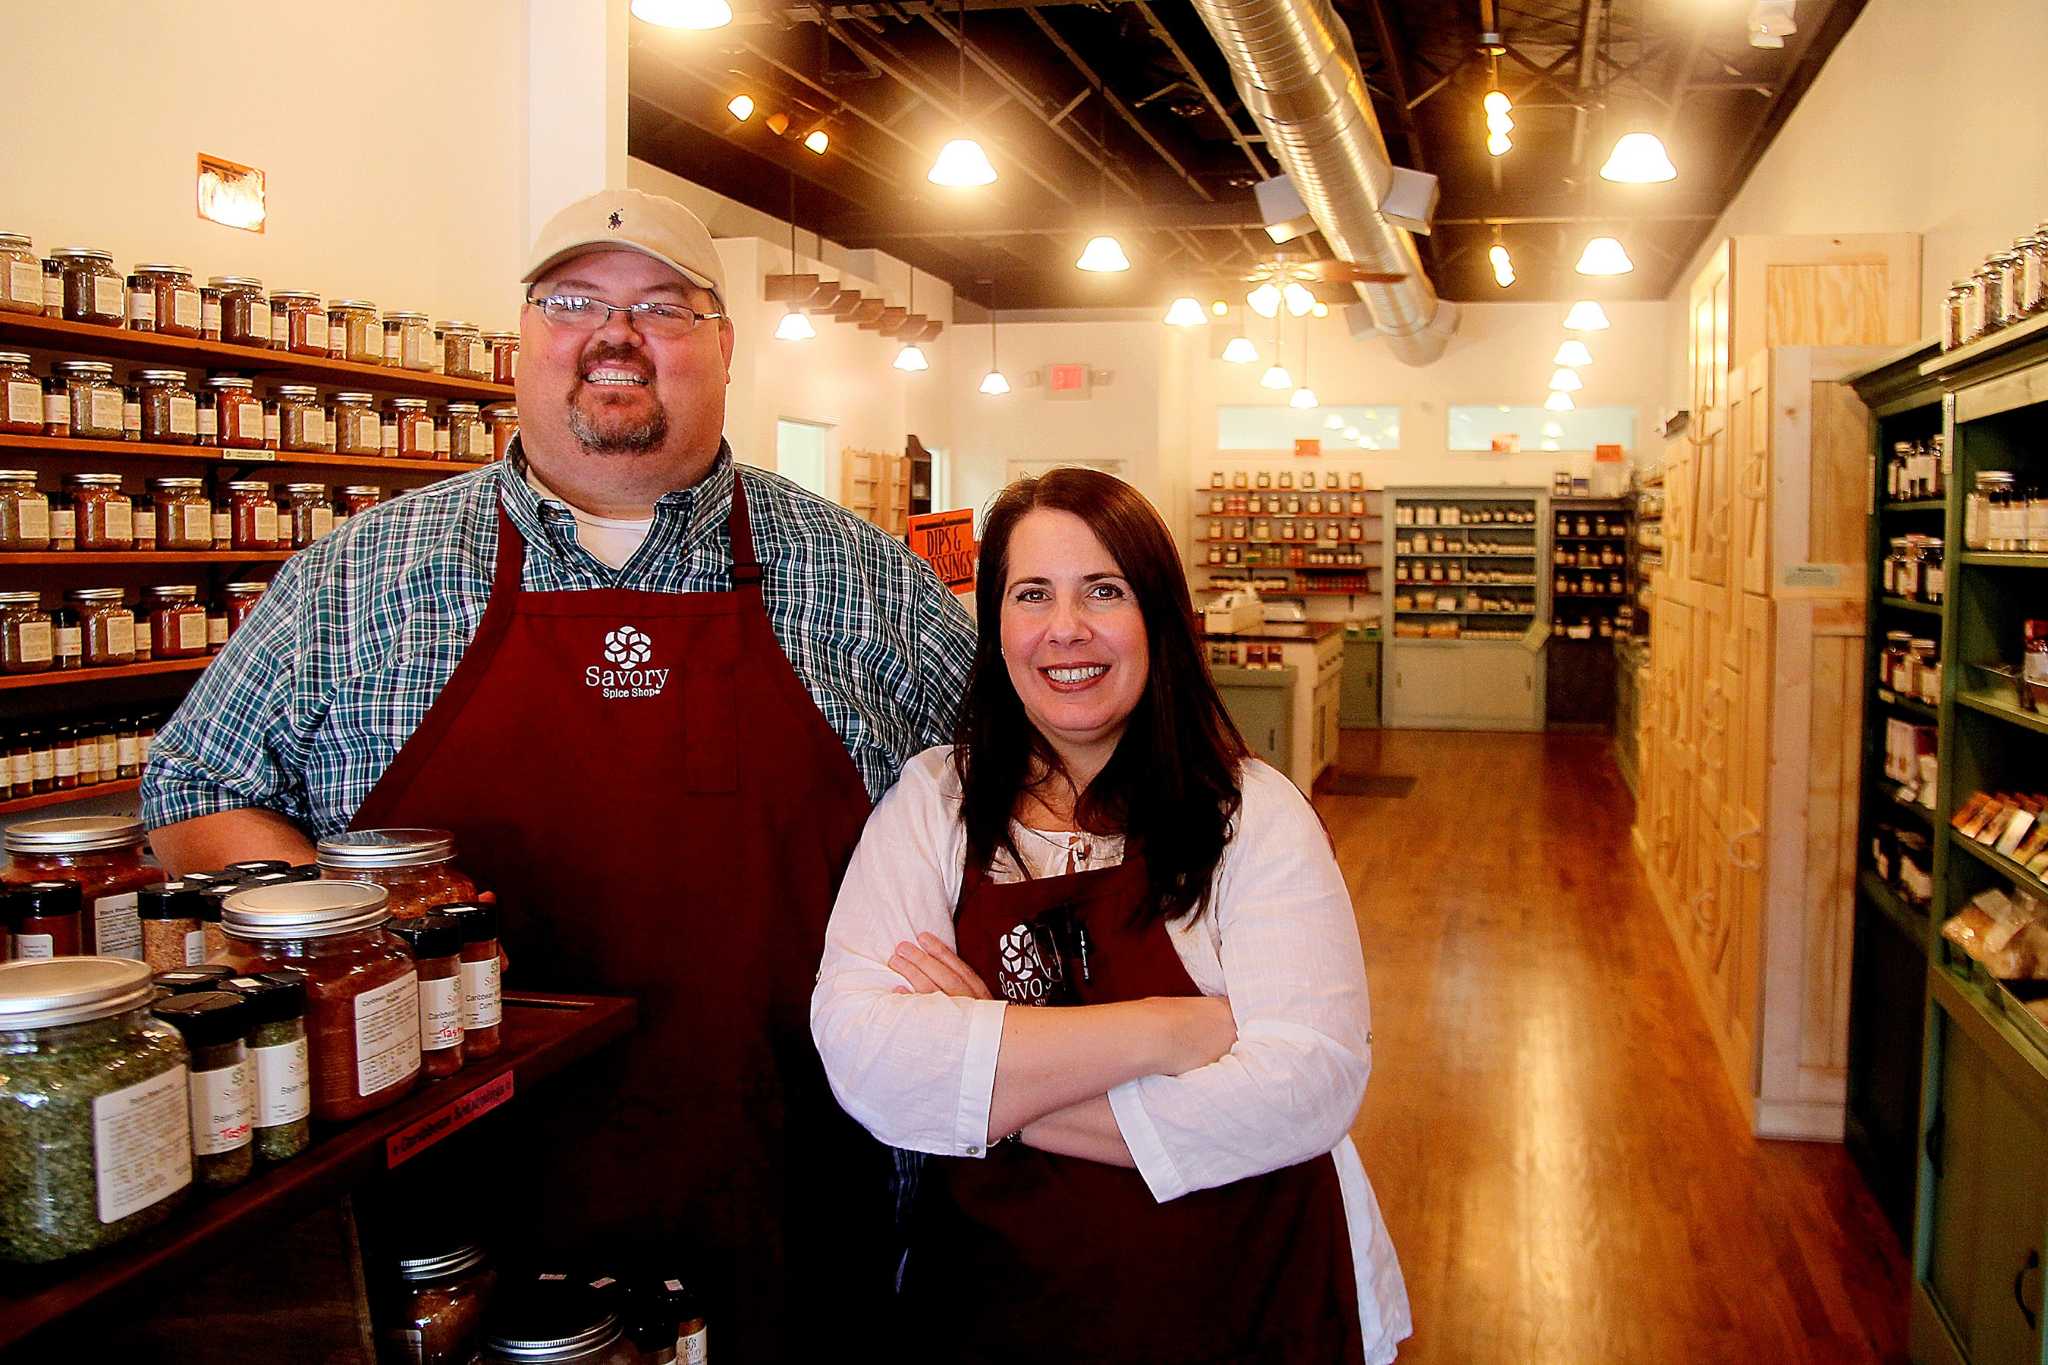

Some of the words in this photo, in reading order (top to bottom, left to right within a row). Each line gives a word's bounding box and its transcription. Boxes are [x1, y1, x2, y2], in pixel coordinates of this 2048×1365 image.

[927, 528, 952, 556] DIPS
[954, 526, 962, 551] &
[929, 550, 973, 580] ESSINGS
[585, 665, 669, 689] Savory
[603, 688, 629, 699] Spice
[632, 687, 655, 697] Shop
[999, 971, 1052, 1000] Savo
